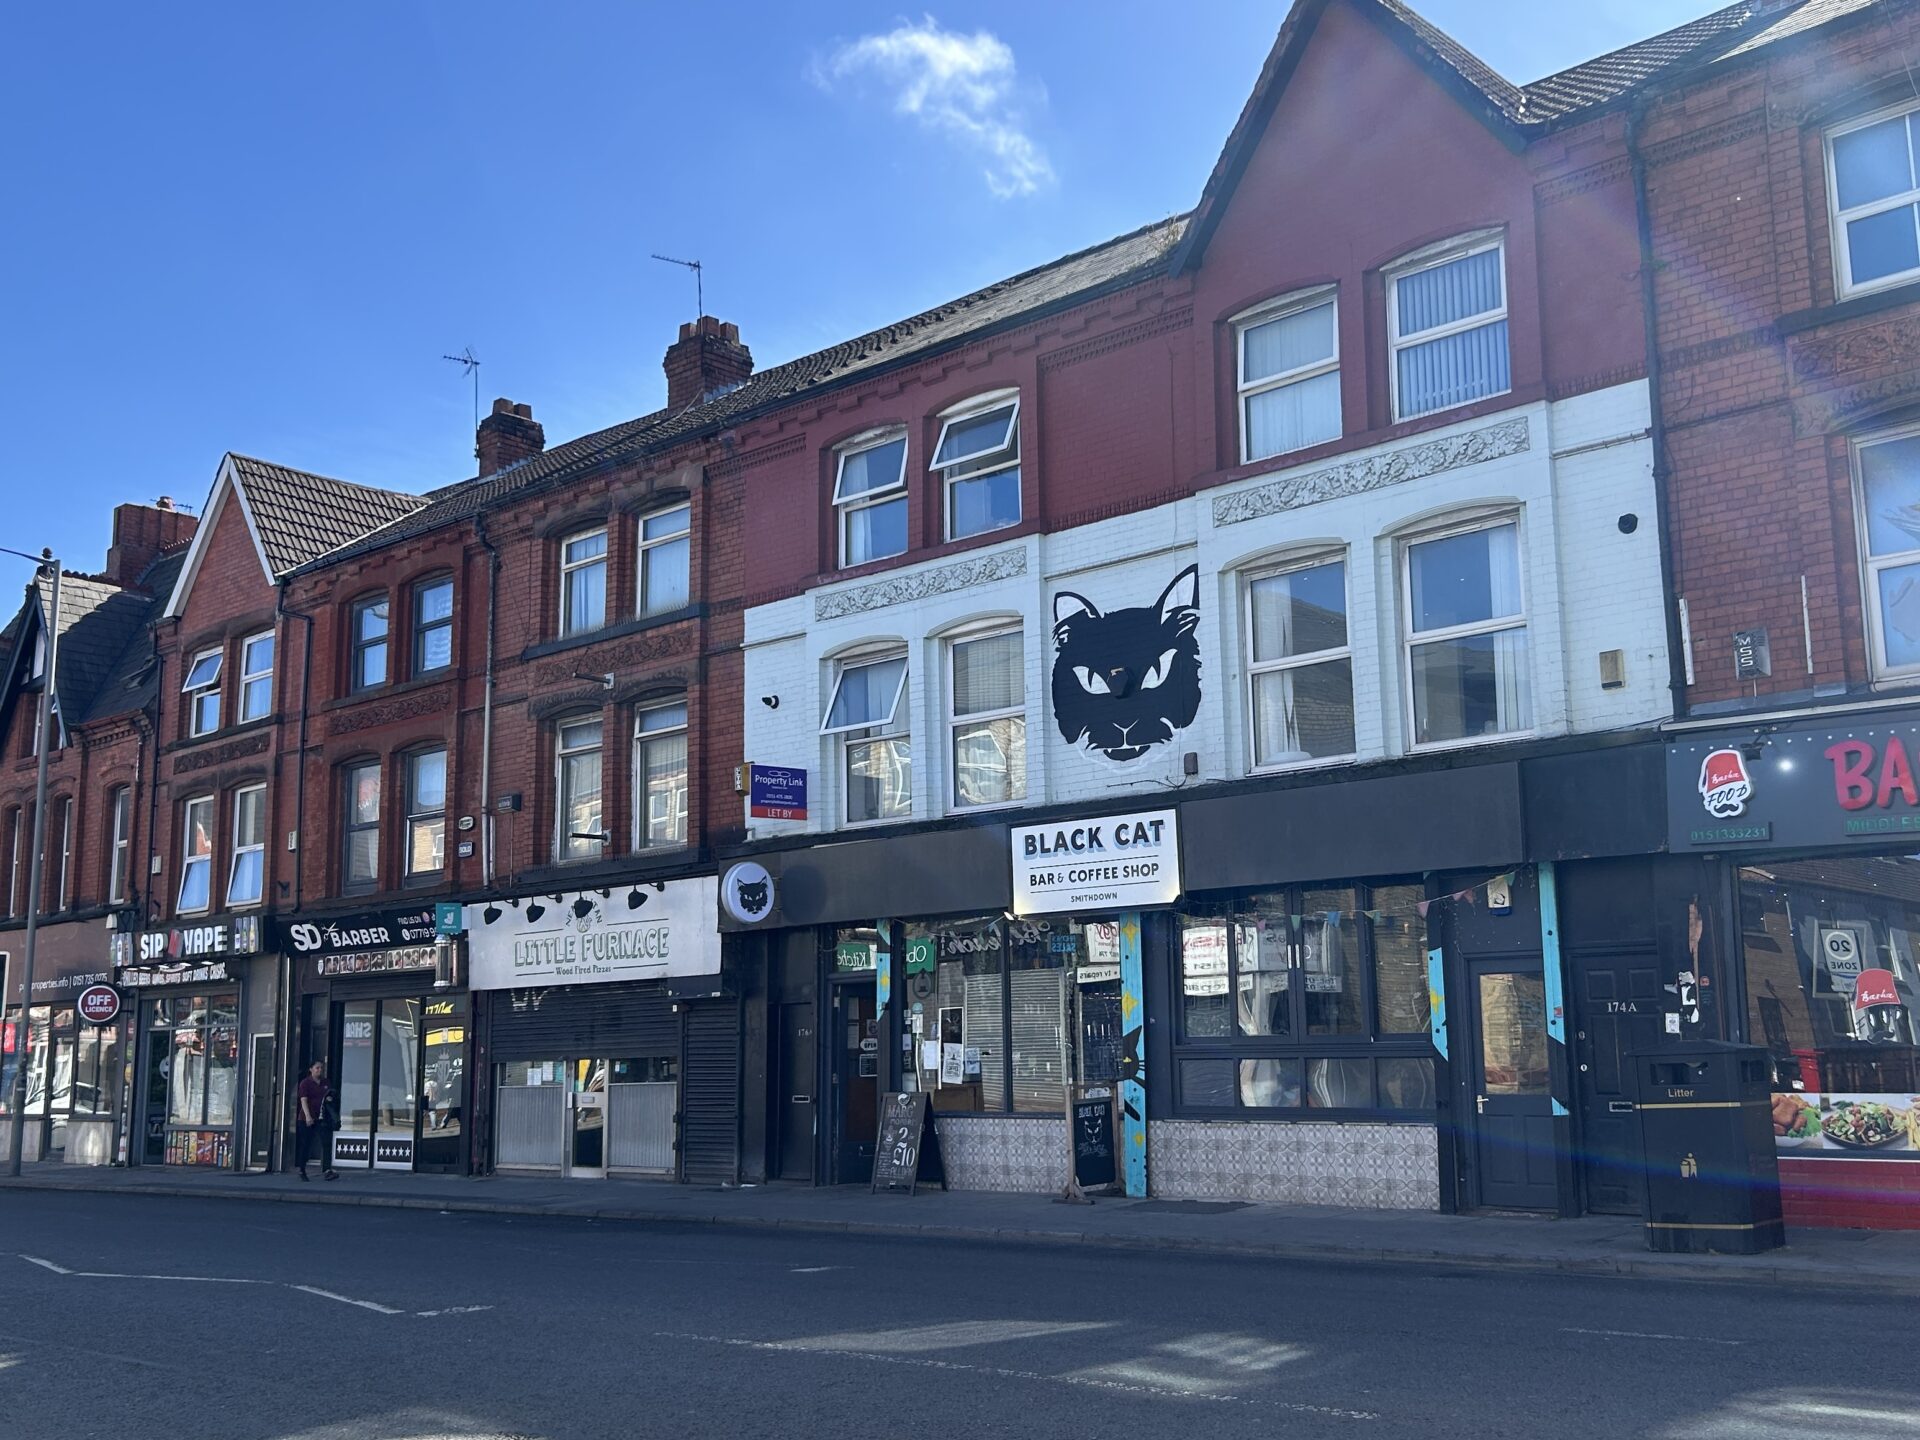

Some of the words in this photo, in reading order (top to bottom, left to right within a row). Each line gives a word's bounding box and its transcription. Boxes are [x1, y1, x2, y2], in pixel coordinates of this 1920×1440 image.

[755, 774, 788, 787] Property
[789, 778, 804, 787] Link
[1824, 736, 1920, 811] BA
[1707, 784, 1748, 806] FOOD
[768, 808, 781, 817] LET
[783, 809, 793, 818] BY
[1024, 826, 1104, 857] BLACK
[1115, 819, 1164, 847] CAT
[1030, 872, 1055, 887] BAR
[1057, 872, 1064, 883] &
[1068, 866, 1119, 883] COFFEE
[1123, 863, 1160, 878] SHOP
[1071, 892, 1118, 903] SMITHDOWN
[140, 933, 164, 959] SIP
[184, 925, 227, 955] VAPE
[290, 923, 322, 951] SD
[330, 927, 391, 947] BARBER
[514, 935, 576, 966] LITTLE
[582, 927, 670, 962] FURNACE
[556, 966, 573, 975] Wood
[574, 965, 591, 974] Fired
[593, 964, 611, 973] Pizzas
[87, 994, 112, 1006] OFF
[1668, 1088, 1694, 1097] Litter
